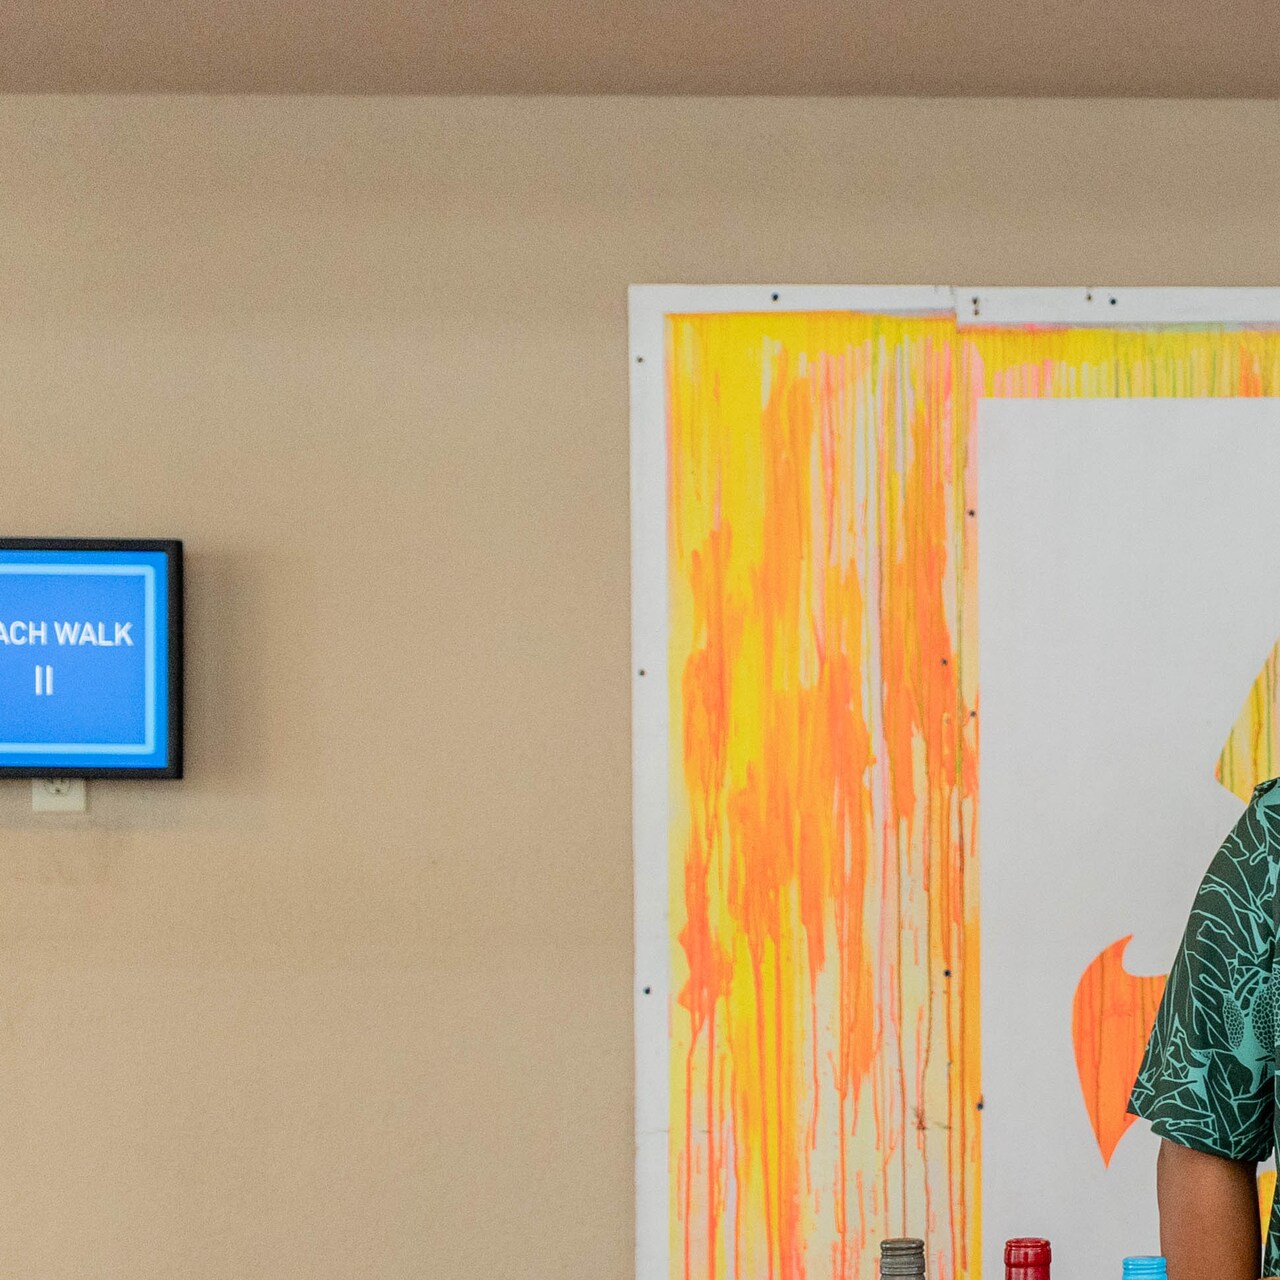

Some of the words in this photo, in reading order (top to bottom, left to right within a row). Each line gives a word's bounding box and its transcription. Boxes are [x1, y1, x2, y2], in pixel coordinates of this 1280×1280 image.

[0, 621, 47, 646] ACH
[54, 621, 134, 646] WALK
[35, 664, 54, 696] II
